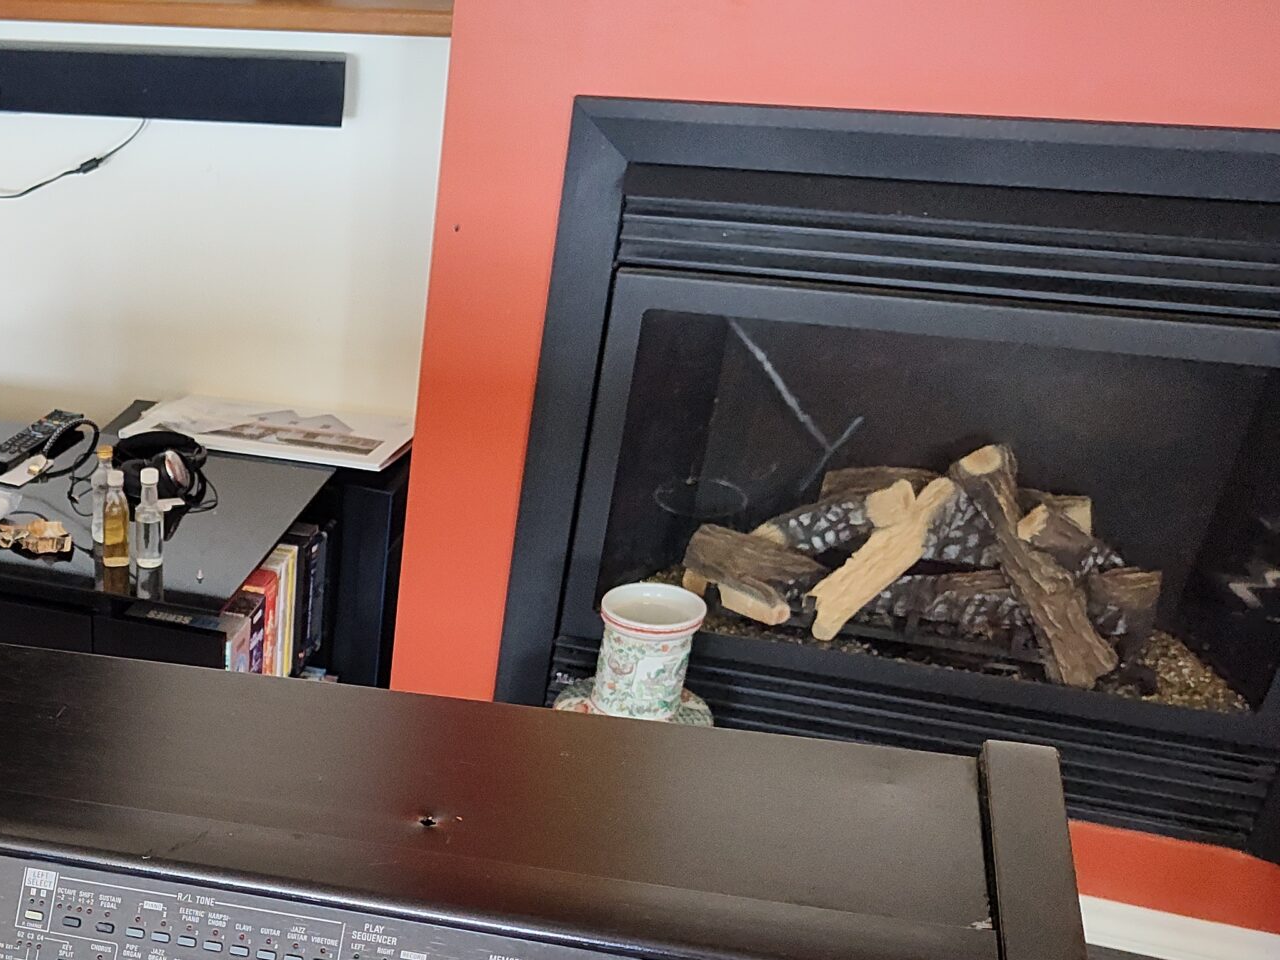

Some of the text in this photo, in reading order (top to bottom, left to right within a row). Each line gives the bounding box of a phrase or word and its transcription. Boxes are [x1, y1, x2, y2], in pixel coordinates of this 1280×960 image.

[32, 871, 49, 879] LEFT
[27, 879, 52, 888] SELECT
[58, 887, 76, 895] OCTAVE
[99, 895, 121, 903] SUSTAIN
[177, 893, 215, 906] R/L TONE
[100, 901, 117, 909] PEDAL
[180, 907, 205, 917] ELECTRIC
[182, 915, 199, 923] PIANO
[208, 919, 226, 928] CHORD
[260, 928, 280, 936] GUITAR
[364, 923, 385, 933] PLAY
[287, 933, 307, 942] GUITAR
[311, 936, 338, 947] VIBETONE
[352, 931, 397, 945] SEQUENCER
[351, 943, 365, 951] LEFT
[377, 947, 395, 955] RIGHT
[59, 950, 74, 958] SPLIT
[123, 950, 141, 958] ORGAN
